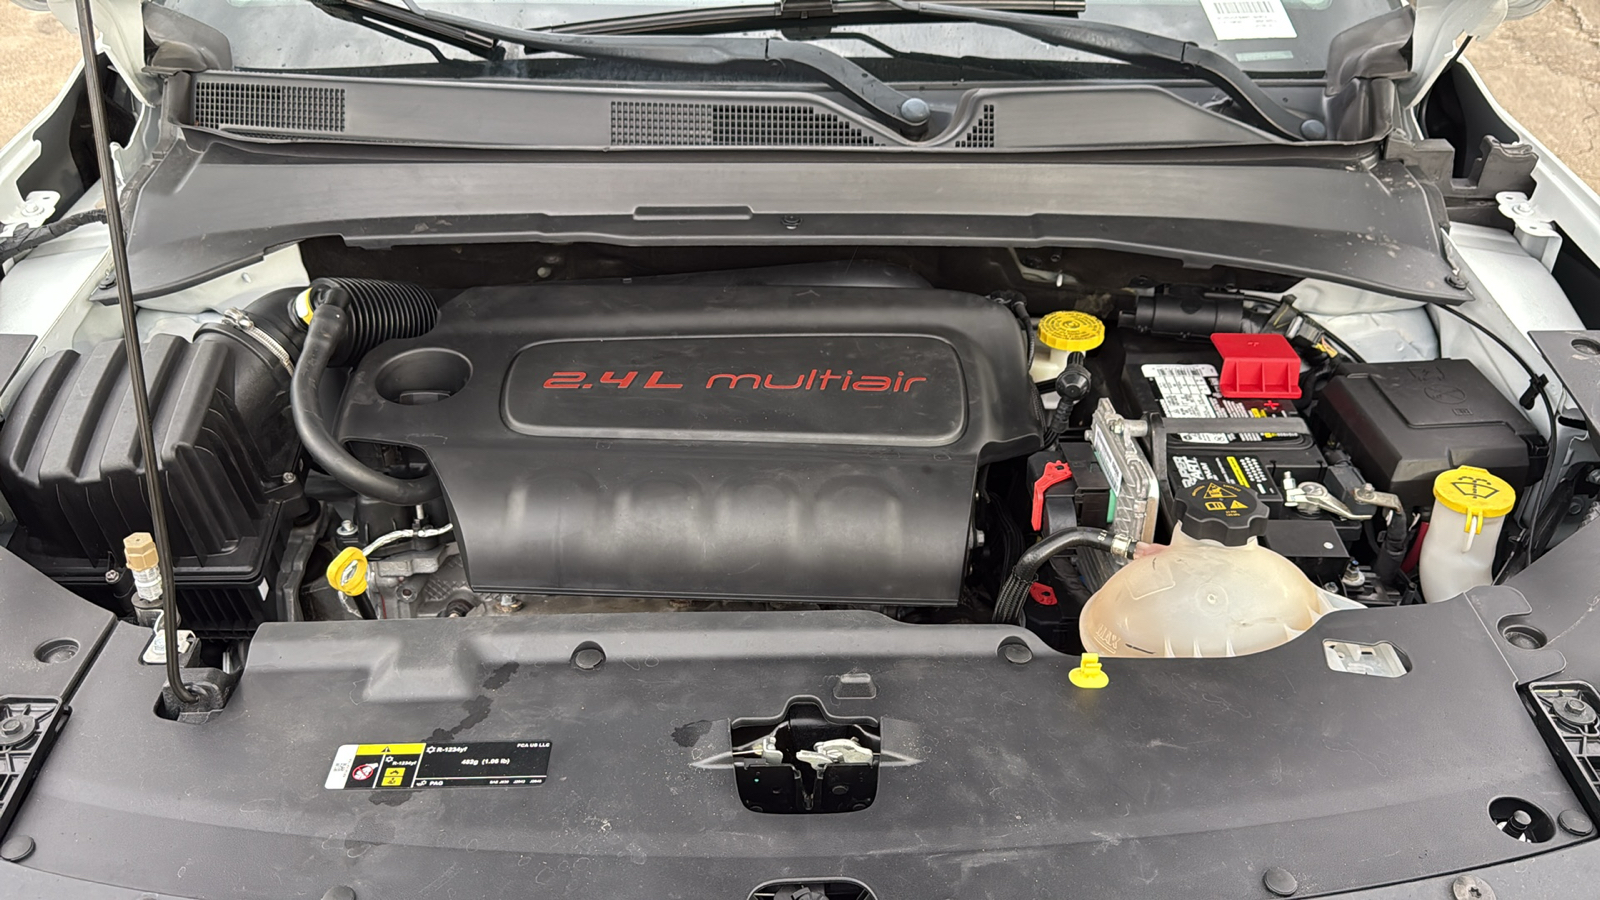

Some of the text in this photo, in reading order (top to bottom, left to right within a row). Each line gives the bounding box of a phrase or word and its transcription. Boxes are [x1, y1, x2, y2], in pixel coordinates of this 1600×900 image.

[706, 369, 927, 392] multiair
[1096, 624, 1121, 649] MAX
[436, 746, 468, 754] R-1234yf
